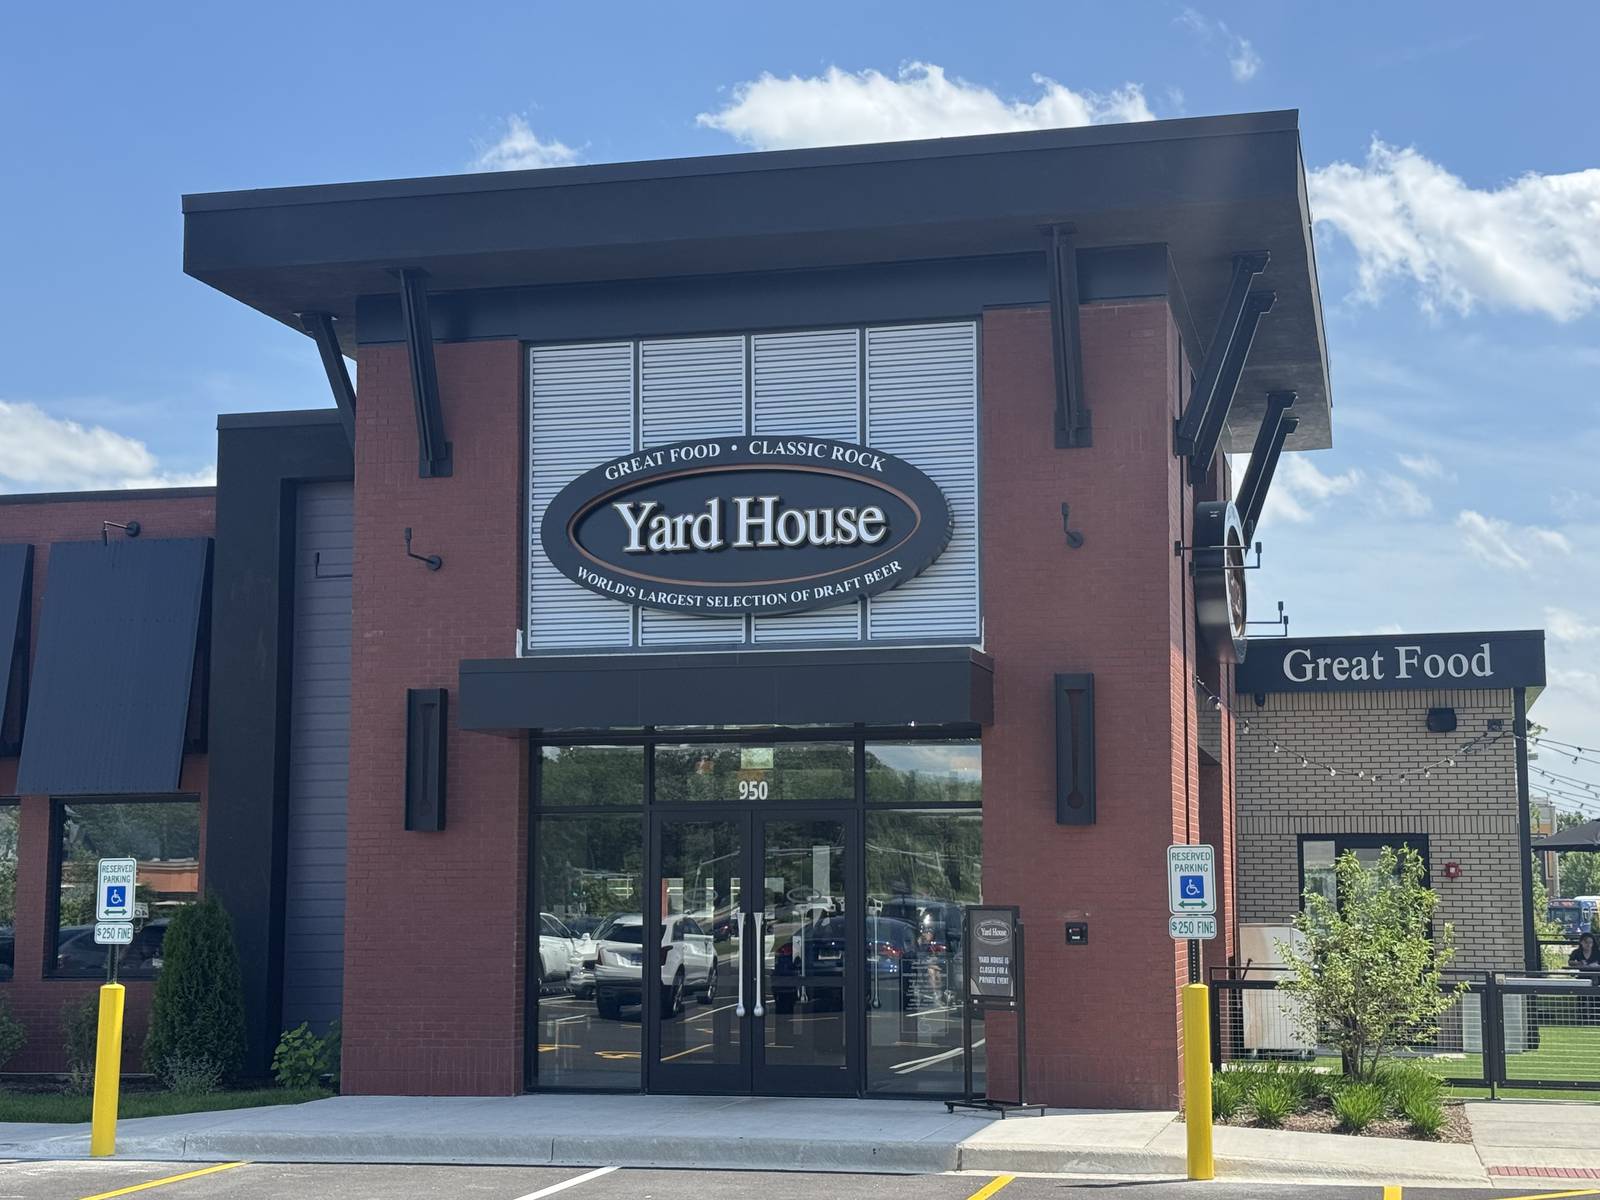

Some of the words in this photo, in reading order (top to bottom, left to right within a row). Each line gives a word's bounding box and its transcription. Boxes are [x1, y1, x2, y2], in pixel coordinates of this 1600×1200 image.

[605, 451, 664, 480] GREAT
[670, 443, 720, 462] FOOD
[749, 440, 827, 458] CLASSIC
[831, 446, 886, 472] ROCK
[613, 497, 722, 553] Yard
[731, 495, 887, 549] House
[577, 566, 636, 598] WORLD'S
[638, 589, 703, 607] LARGEST
[706, 593, 787, 608] SELECTION
[791, 589, 810, 603] OF
[814, 576, 861, 599] DRAFT
[864, 560, 902, 585] BEER
[1283, 648, 1385, 682] Great
[1394, 643, 1495, 679] Food
[738, 780, 769, 800] 950
[1171, 852, 1211, 861] RESERVED
[102, 864, 133, 873] RESERVED
[1174, 864, 1209, 872] PARKING
[103, 875, 131, 883] PARKING
[97, 928, 115, 939] $250
[117, 928, 132, 939] FINE
[981, 928, 992, 936] Yard
[1171, 921, 1194, 934] $250
[1197, 921, 1214, 934] FINE
